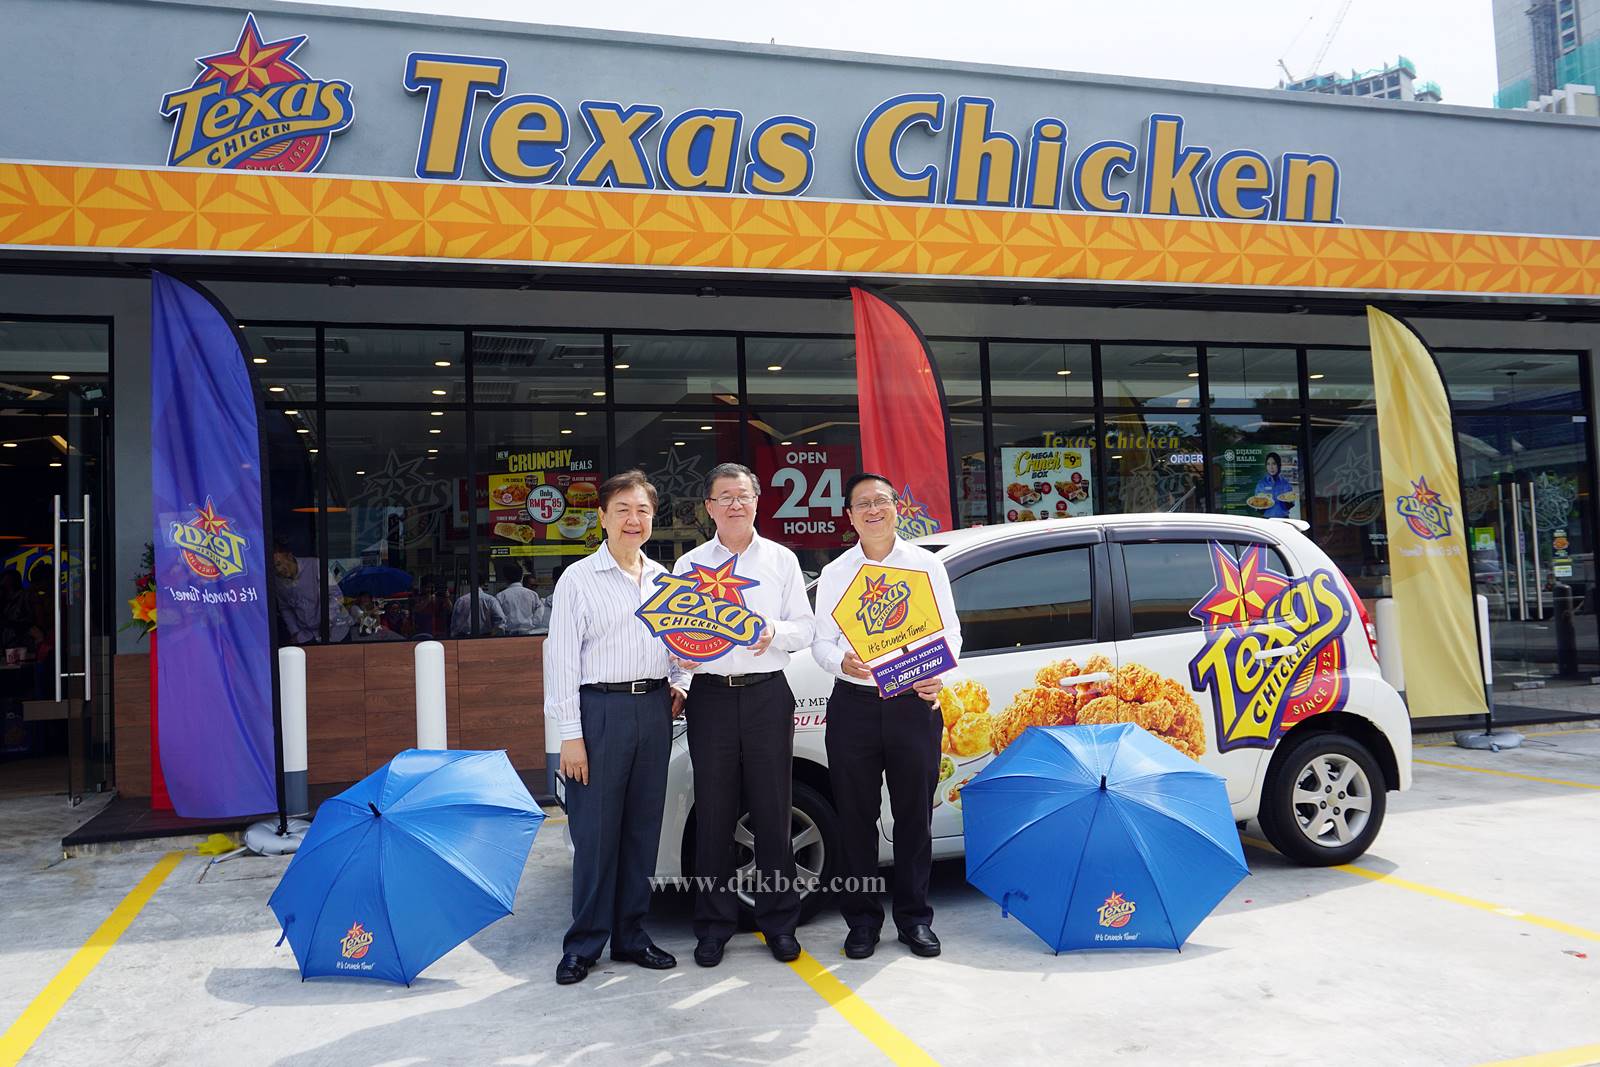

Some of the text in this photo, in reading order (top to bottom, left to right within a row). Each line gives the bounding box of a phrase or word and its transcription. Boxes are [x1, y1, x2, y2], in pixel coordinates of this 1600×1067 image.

[166, 81, 346, 162] Texas
[206, 123, 291, 166] CHICKEN
[404, 52, 1343, 223] Texas Chicken
[289, 139, 311, 165] 1952
[1042, 431, 1181, 449] Texas Chicken
[497, 450, 509, 460] NEW
[508, 449, 573, 473] CRUNCHY
[570, 460, 593, 471] DEALS
[786, 451, 827, 464] OPEN
[1031, 451, 1053, 460] MEGA
[1170, 453, 1204, 464] ORDER
[1031, 471, 1048, 479] BOX
[539, 489, 553, 498] Only
[770, 467, 845, 519] 24
[783, 520, 836, 534] HOURS
[642, 575, 763, 641] Texas
[857, 581, 910, 632] Texas
[659, 616, 719, 631] CHICKEN
[675, 635, 723, 651] SINCE 1952
[868, 621, 927, 654] It's Crunch Time!
[877, 644, 944, 678] SHELL SUNWAY MENTARI
[1197, 574, 1344, 737] Texas
[898, 656, 943, 683] DRIVE THRU
[1292, 651, 1331, 716] SINCE 1952
[1097, 902, 1136, 926] Texas
[340, 931, 373, 957] Texas
